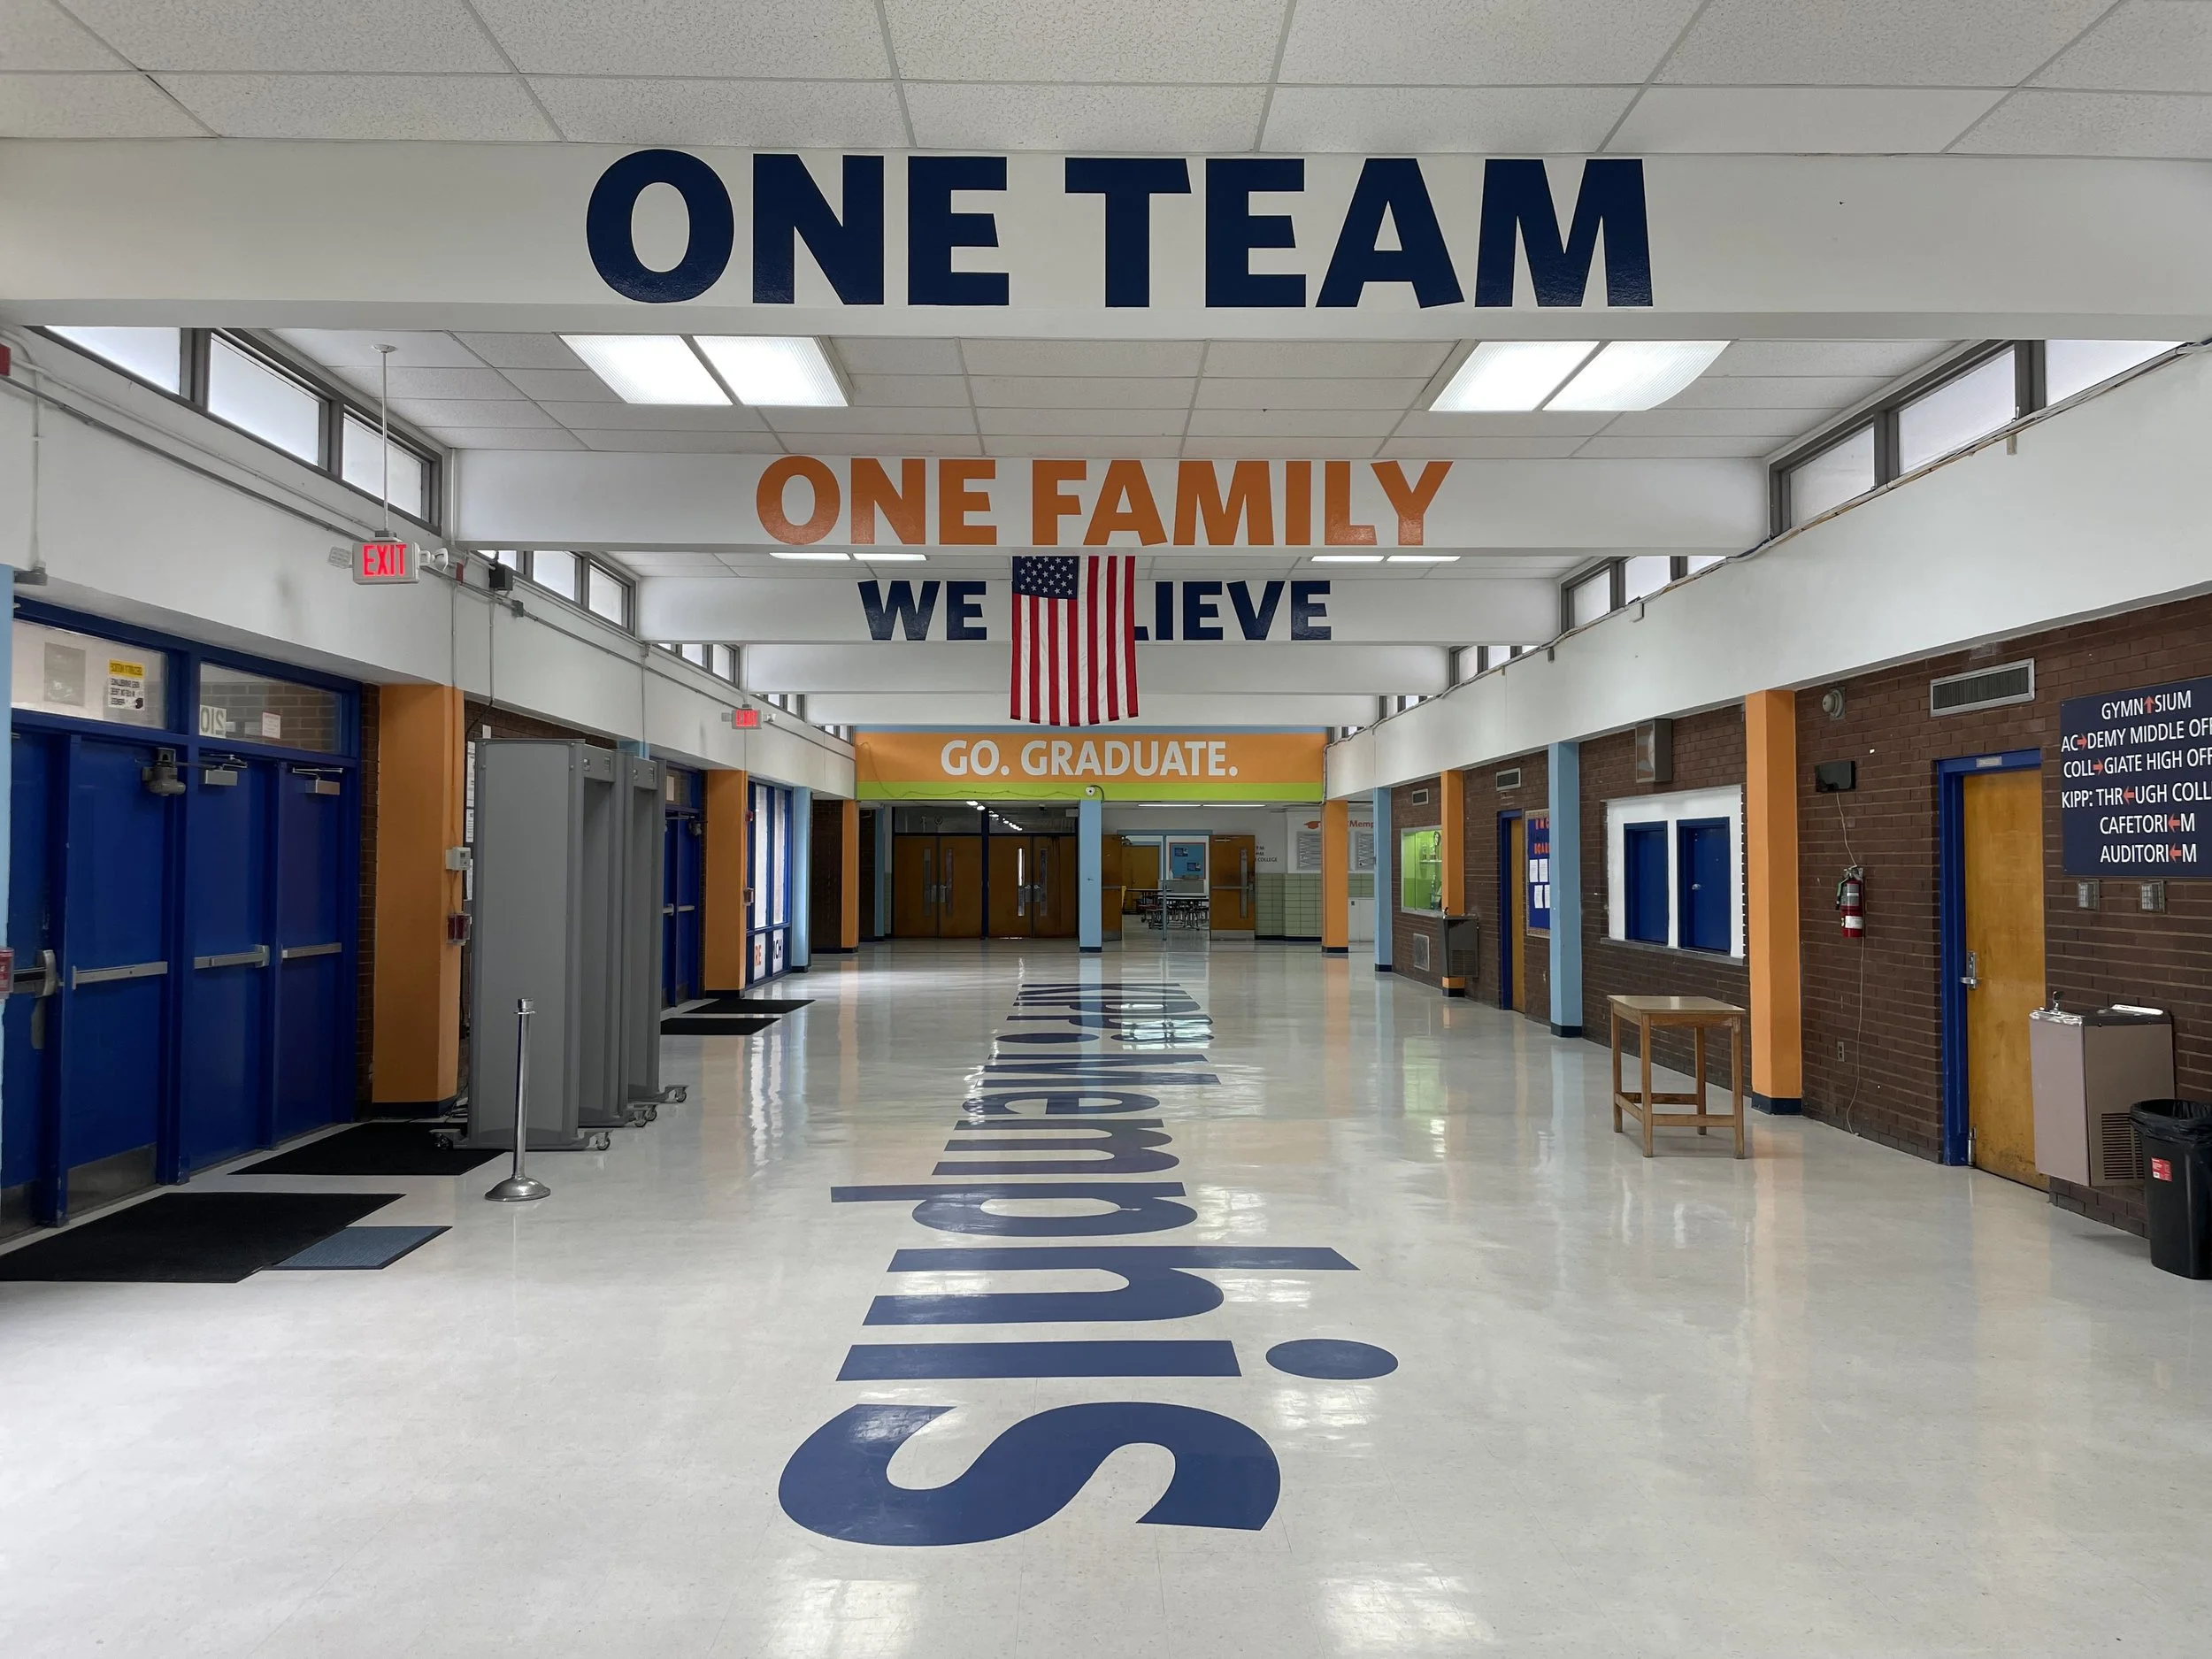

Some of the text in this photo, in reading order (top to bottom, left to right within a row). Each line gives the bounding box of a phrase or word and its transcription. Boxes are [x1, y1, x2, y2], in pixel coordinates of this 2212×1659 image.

[586, 149, 1654, 309] ONE TEAM
[757, 456, 1452, 546] ONE FAMILY
[362, 543, 407, 577] EXIT
[857, 580, 1332, 641] WE IEVE
[2130, 720, 2184, 744] MIDDLE
[941, 740, 1239, 777] GO. GRADUATE.
[2147, 750, 2183, 771] HIGH
[2062, 788, 2093, 809] KIPP:
[2172, 781, 2212, 802] COLL
